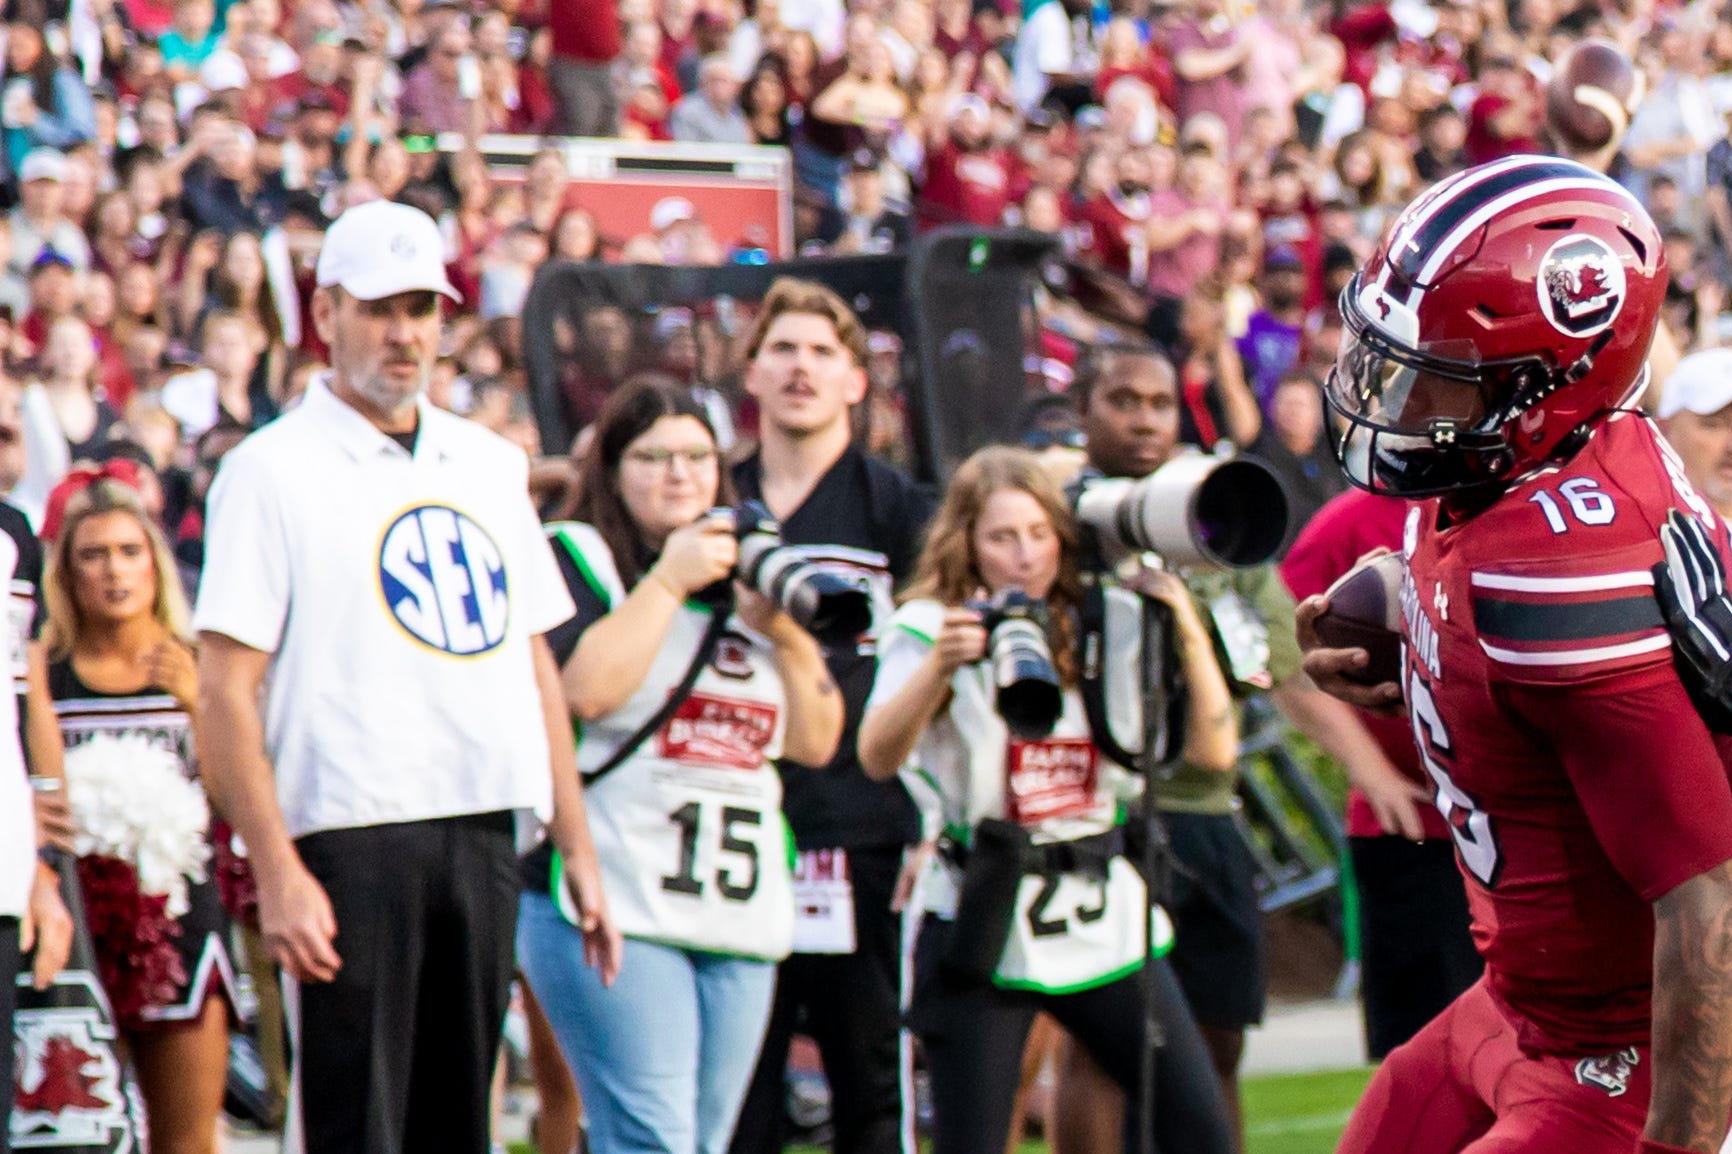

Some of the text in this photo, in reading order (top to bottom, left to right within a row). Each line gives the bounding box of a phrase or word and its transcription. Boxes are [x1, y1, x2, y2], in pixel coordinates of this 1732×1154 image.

[1528, 476, 1617, 535] 16
[380, 506, 508, 655] SEC
[661, 801, 762, 902] 15
